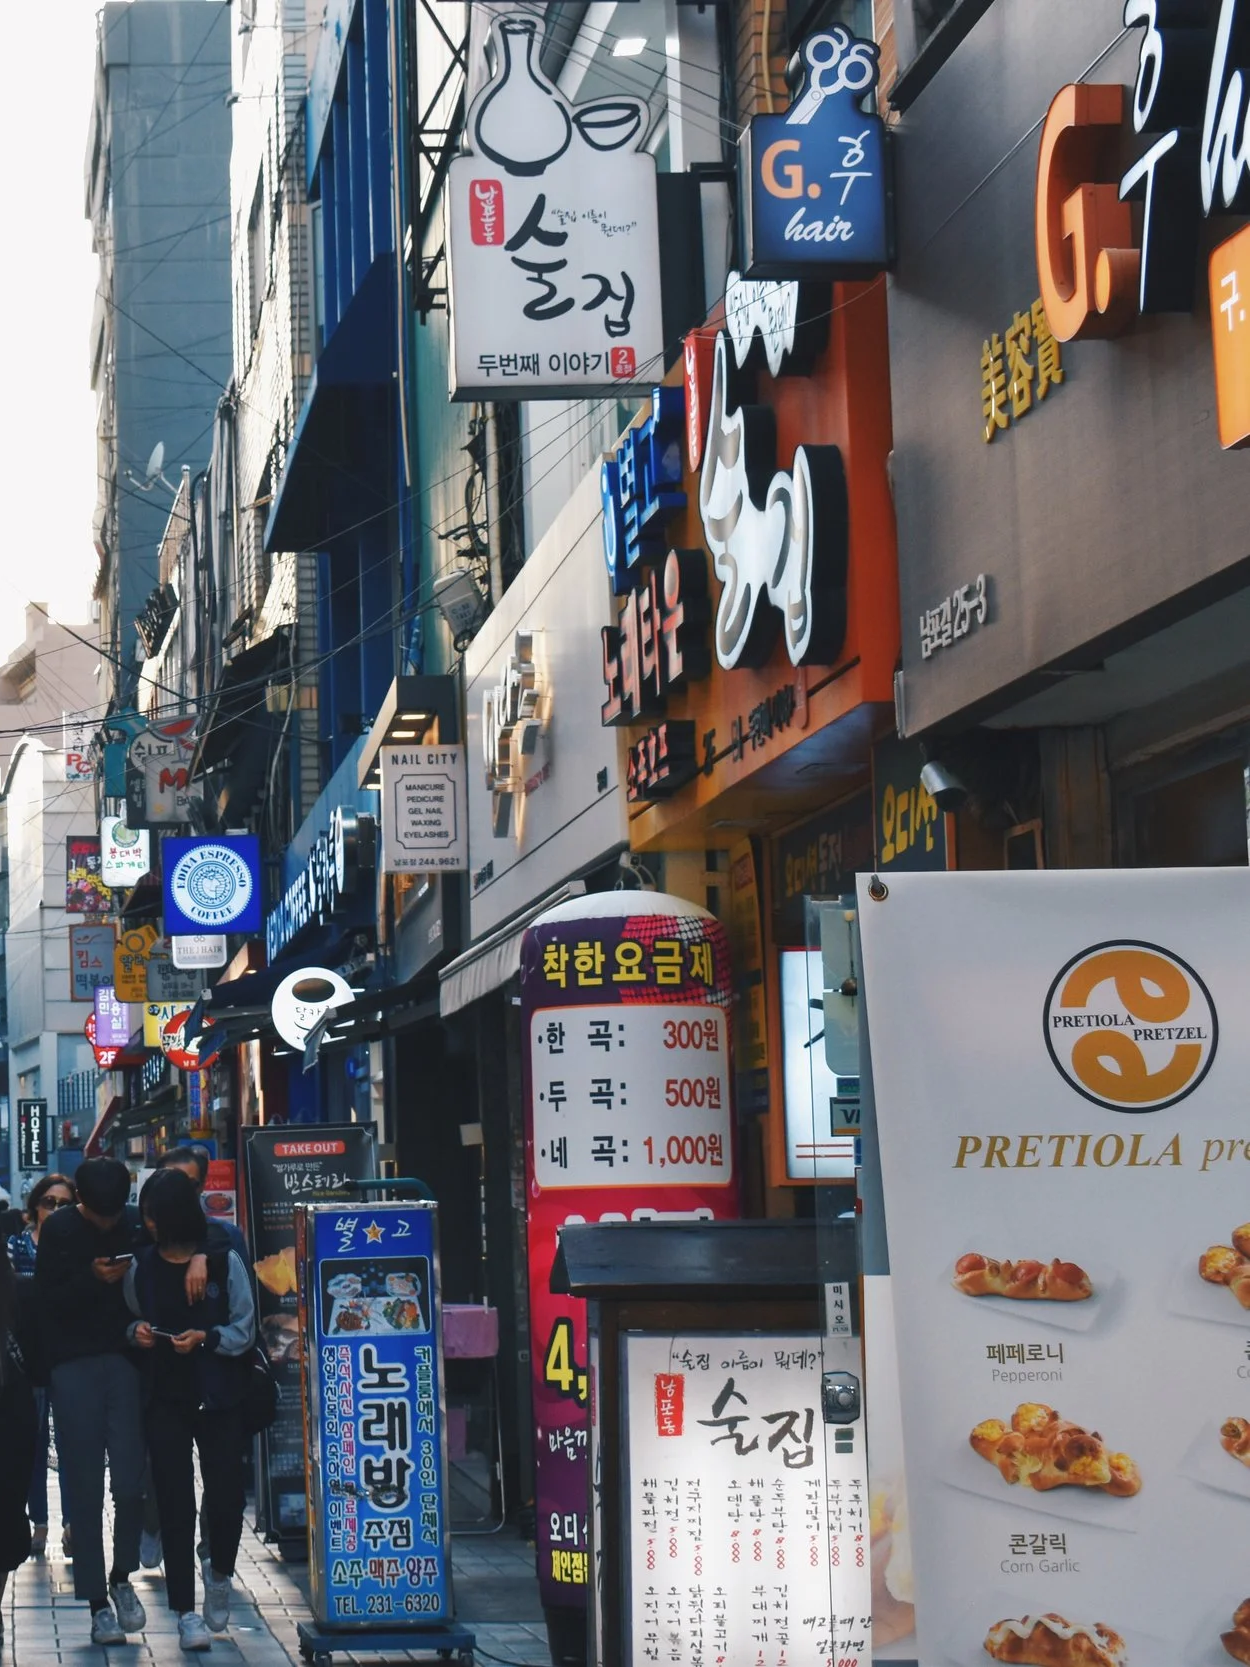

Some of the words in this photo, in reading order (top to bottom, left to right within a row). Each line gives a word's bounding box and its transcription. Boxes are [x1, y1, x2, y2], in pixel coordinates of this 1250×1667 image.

[784, 207, 855, 243] hair
[504, 193, 635, 338] 술집
[477, 352, 540, 377] 두번째
[548, 351, 610, 375] 이야기
[920, 597, 952, 660] 남포길
[953, 573, 988, 638] 25-3
[391, 753, 422, 765] NAIL
[427, 752, 458, 765] CITY
[425, 807, 443, 815] NAIL
[410, 819, 441, 827] WAXING
[403, 831, 449, 839] EYELASHES
[177, 857, 198, 889] EDIYA
[199, 850, 247, 888] ESPRESSO
[418, 857, 460, 867] 244.9621
[191, 905, 234, 920] COFFEE
[177, 946, 196, 955] THE
[201, 945, 223, 954] HAIR
[1053, 1013, 1136, 1029] PRETIOLA
[662, 1018, 719, 1053] 300원
[1133, 1026, 1207, 1042] PRETZEL
[99, 1051, 116, 1064] 2F
[665, 1077, 722, 1111] 500원
[30, 1105, 40, 1165] HOTEL
[282, 1143, 312, 1155] TAKE
[313, 1141, 339, 1154] OUT
[642, 1133, 724, 1168] 1,000원
[952, 1132, 1184, 1169] PRETIOLA
[720, 1349, 764, 1372] 이름이
[986, 1343, 1064, 1365] 페페로니
[992, 1368, 1063, 1384] Pepperoni
[358, 1345, 415, 1513] 노래방
[696, 1377, 815, 1470] 술집
[363, 1519, 414, 1551] 주점
[550, 1511, 587, 1546] 오디
[1008, 1532, 1068, 1556] 콘갈릭
[551, 1549, 588, 1585] 체인점
[1000, 1559, 1035, 1574] Corn
[1039, 1558, 1081, 1575] Garlic
[335, 1597, 363, 1616] TEL.
[367, 1593, 440, 1615] 231-6320
